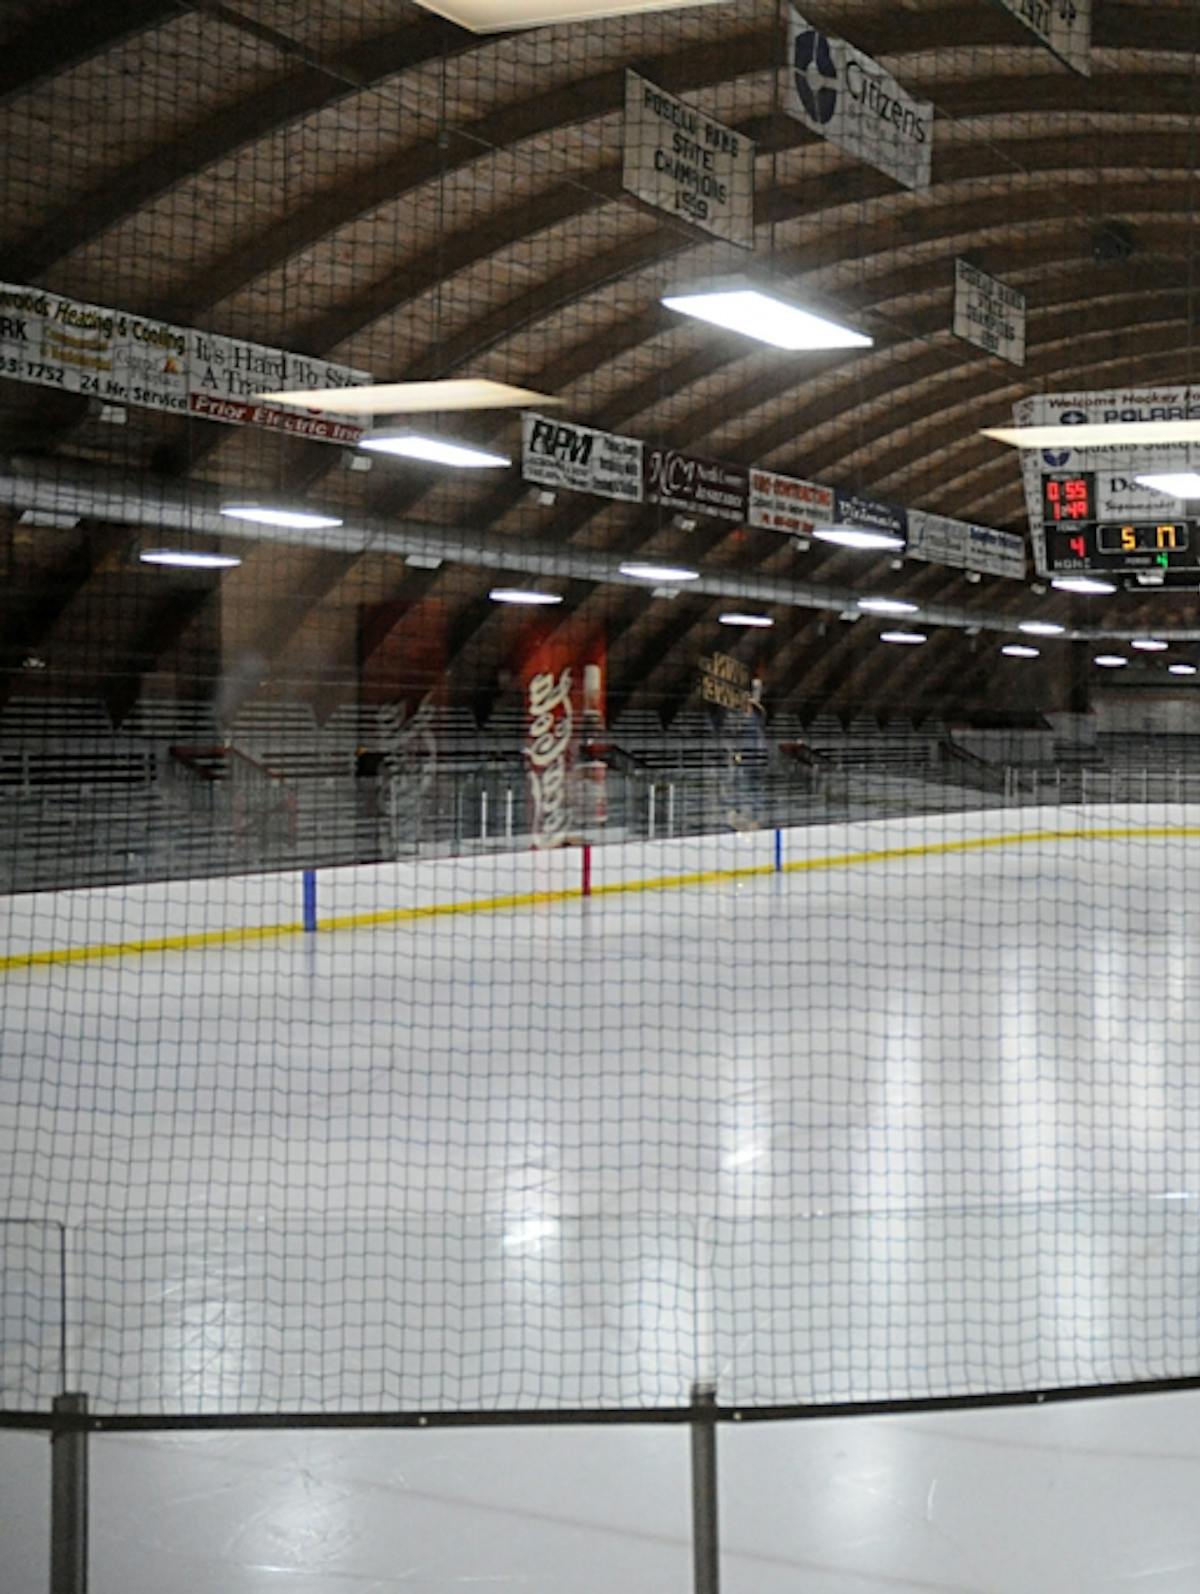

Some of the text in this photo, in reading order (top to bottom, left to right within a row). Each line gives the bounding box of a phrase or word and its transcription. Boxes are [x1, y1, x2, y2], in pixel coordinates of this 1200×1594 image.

[845, 60, 926, 144] Citizens
[53, 302, 113, 339] Heating
[132, 321, 186, 356] Cooling
[195, 336, 226, 365] It's
[234, 346, 288, 381] Hard
[293, 358, 319, 386] To
[201, 366, 218, 390] A
[80, 374, 100, 392] 24
[134, 386, 188, 409] Service
[1049, 396, 1116, 408] Welcome
[1122, 392, 1180, 405] Hockey
[195, 395, 246, 421] Prior
[250, 409, 329, 437] Electric
